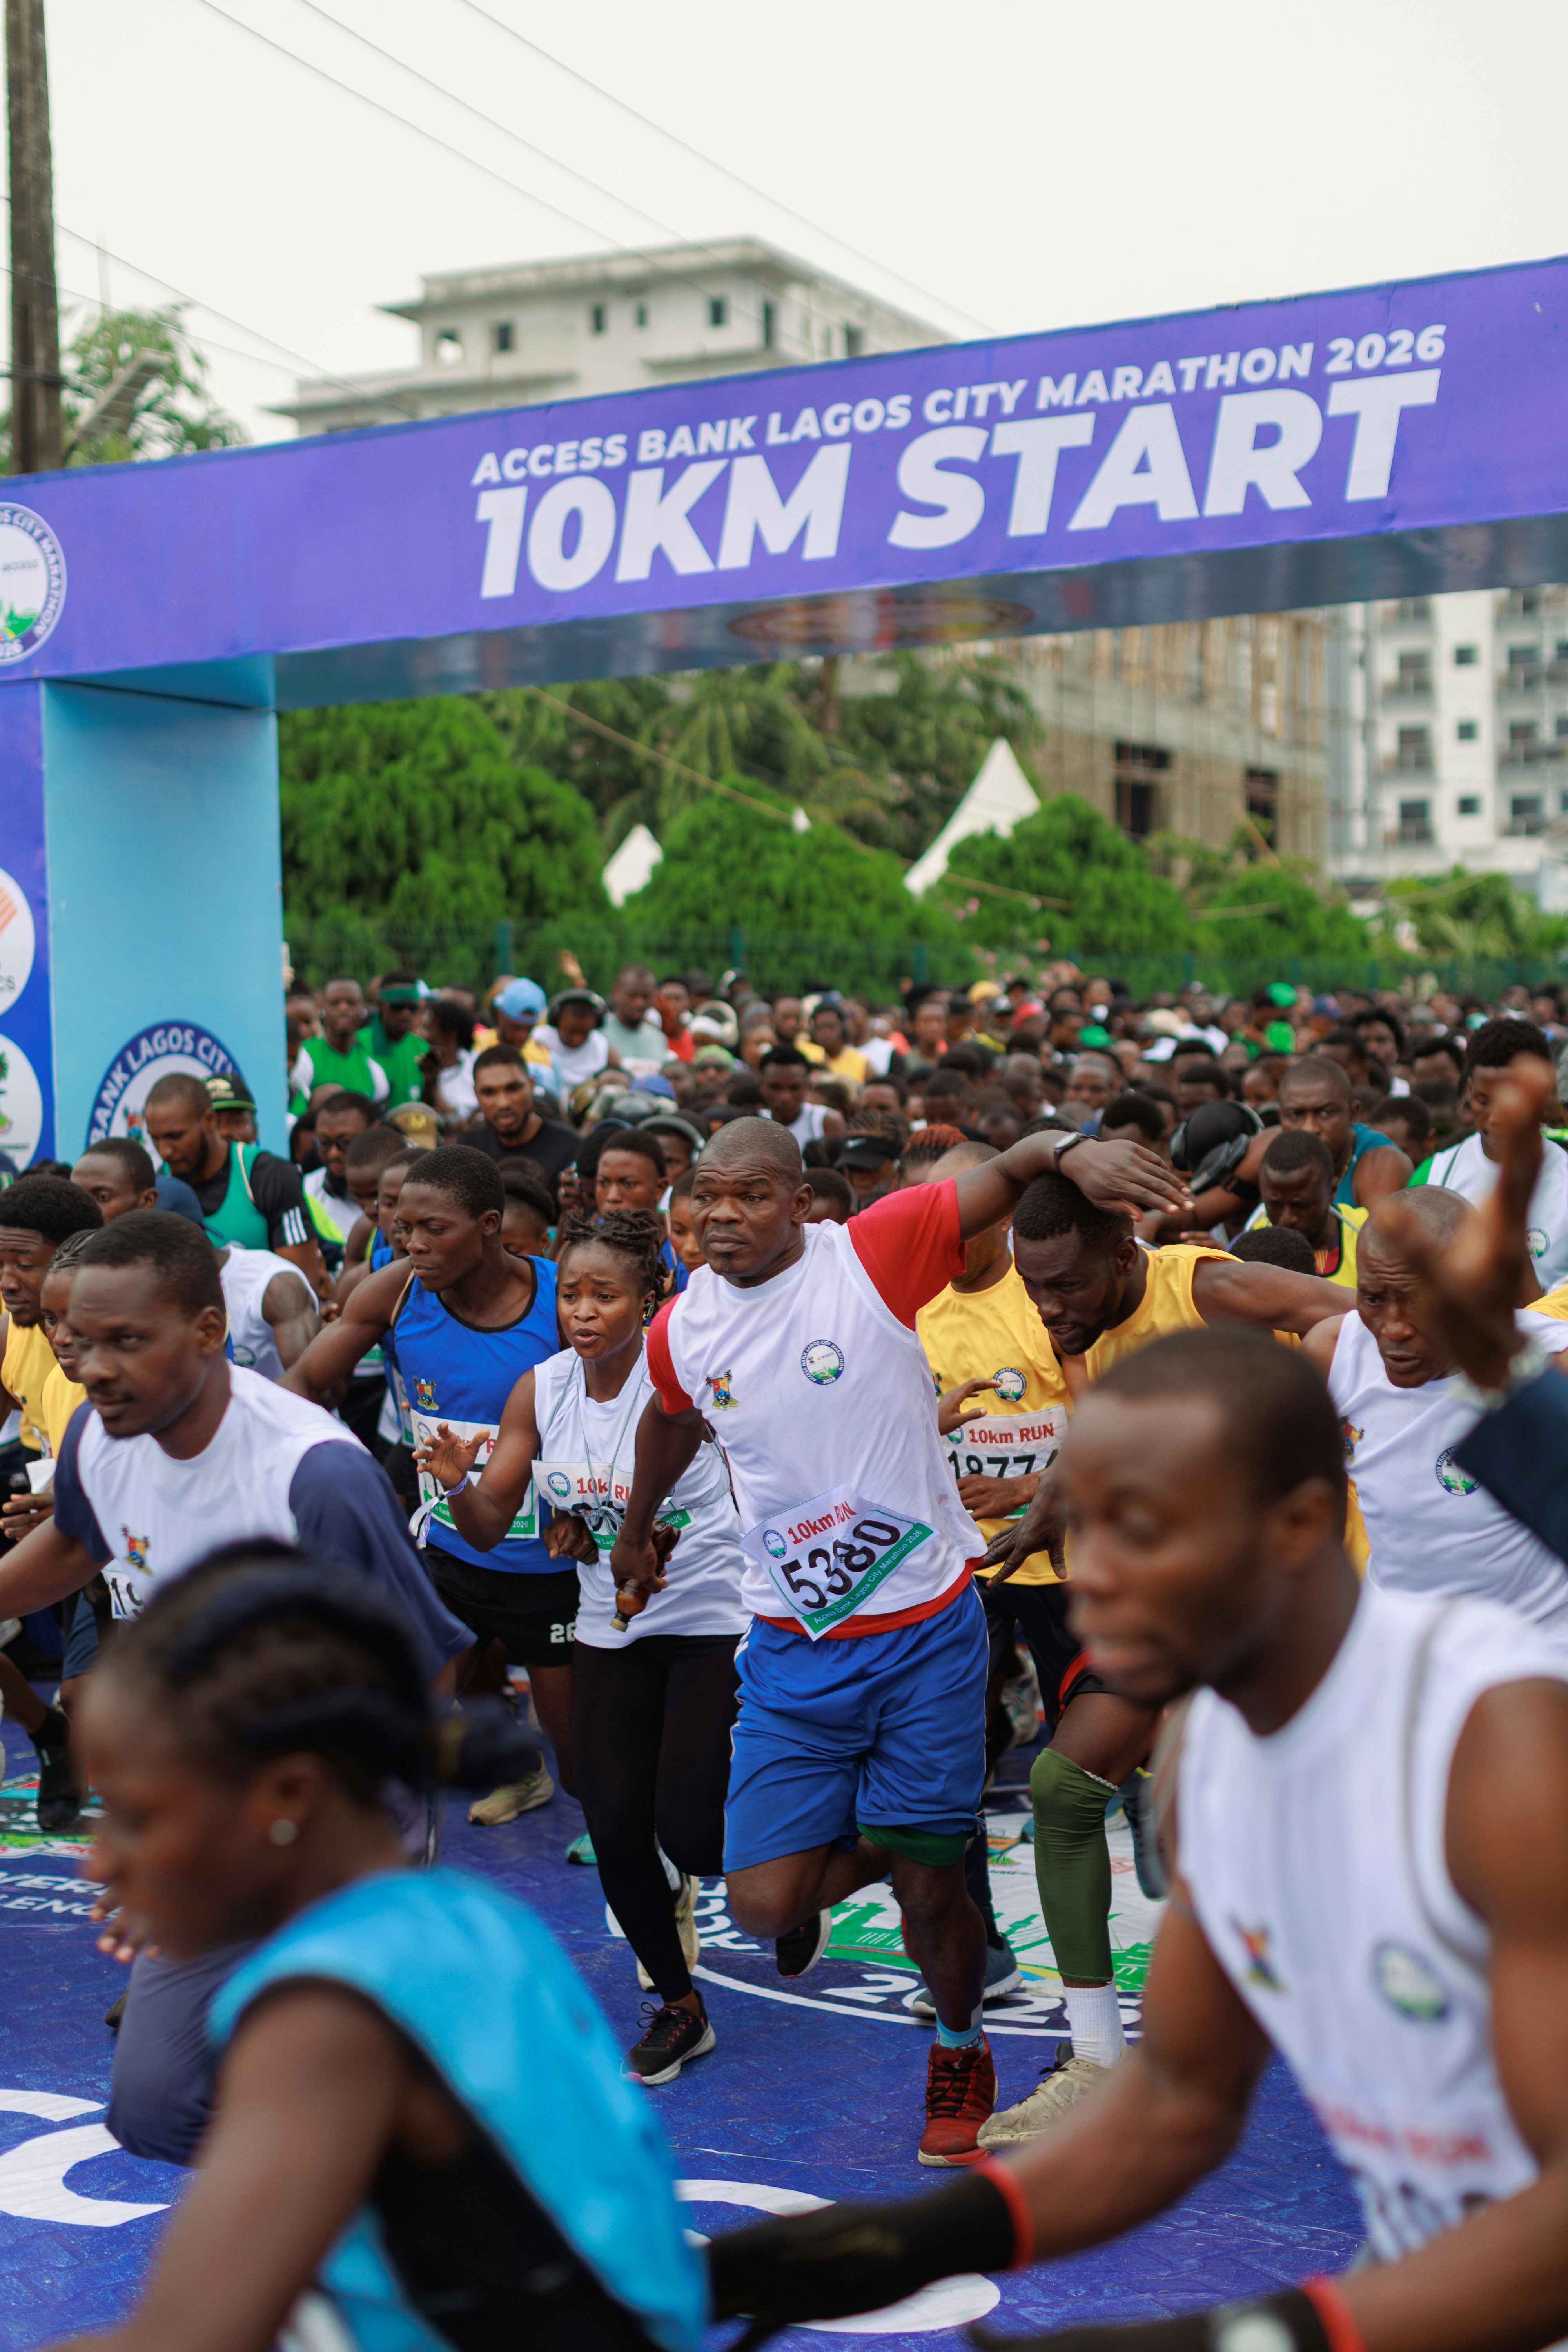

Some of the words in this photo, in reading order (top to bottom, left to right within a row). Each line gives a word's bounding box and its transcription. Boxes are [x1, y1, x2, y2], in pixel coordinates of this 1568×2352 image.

[471, 433, 628, 486] ACCESS
[637, 415, 758, 463] BANK
[766, 393, 913, 446] LAGOS
[922, 378, 1029, 423] CITY
[1036, 342, 1314, 410] MARATHON
[1324, 324, 1447, 374] 2026
[475, 441, 853, 599] 10KM
[886, 368, 1442, 550] START
[12, 512, 43, 541] CITY
[89, 1061, 130, 1145] BANK
[125, 1027, 195, 1073] LAGOS
[805, 1341, 821, 1352] LAGOS
[802, 1367, 817, 1382] ACCESS
[822, 1376, 837, 1385] 2026
[969, 1428, 1014, 1444] 10km
[1019, 1422, 1055, 1443] RUN
[577, 1477, 610, 1494] 10k
[666, 1514, 682, 1525] 2026
[787, 1514, 836, 1545] 10km
[833, 1501, 857, 1524] RUN
[603, 1538, 616, 1547] Lago
[780, 1519, 900, 1609] 5380
[813, 1609, 836, 1624] Access
[834, 1599, 853, 1615] Bank
[851, 1582, 871, 1602] Lagos
[867, 1568, 882, 1583] City
[878, 1543, 908, 1570] Marathon
[906, 1529, 923, 1544] 2026
